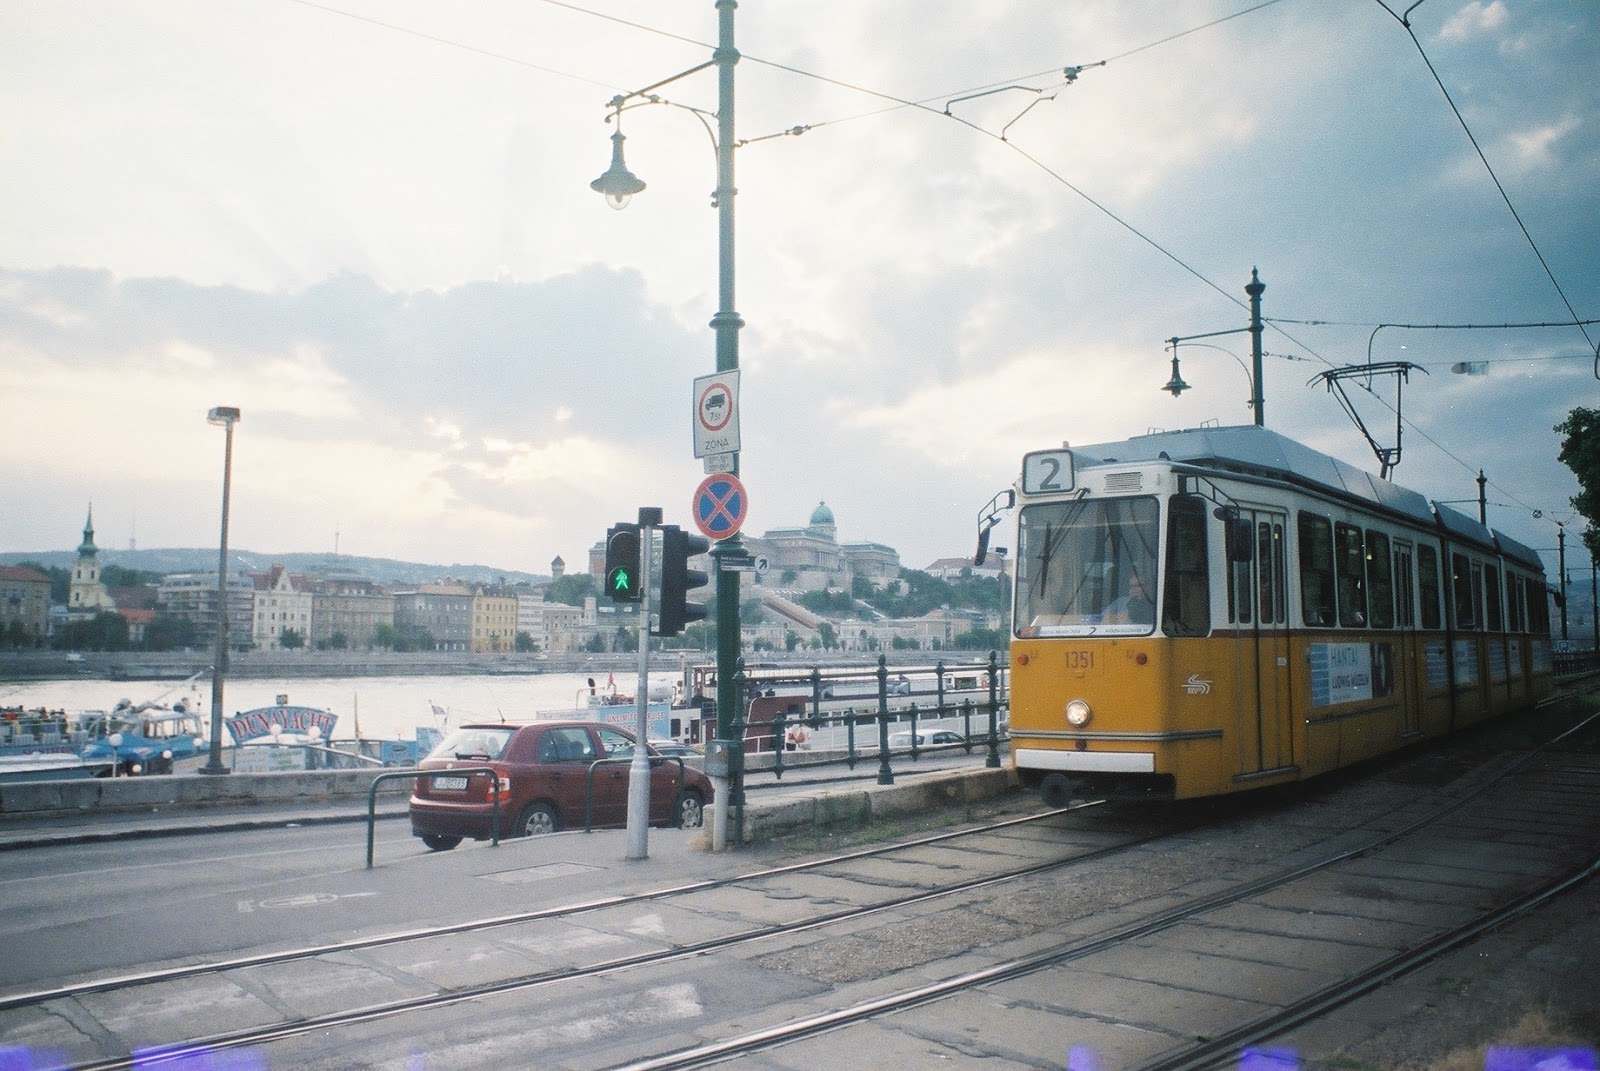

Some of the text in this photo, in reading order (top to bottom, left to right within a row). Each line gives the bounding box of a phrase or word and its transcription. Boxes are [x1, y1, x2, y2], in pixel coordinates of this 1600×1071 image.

[1039, 457, 1061, 490] 2
[1088, 626, 1097, 636] 2
[1065, 651, 1094, 668] 1351
[607, 711, 664, 723] UNLIMITE RUISE
